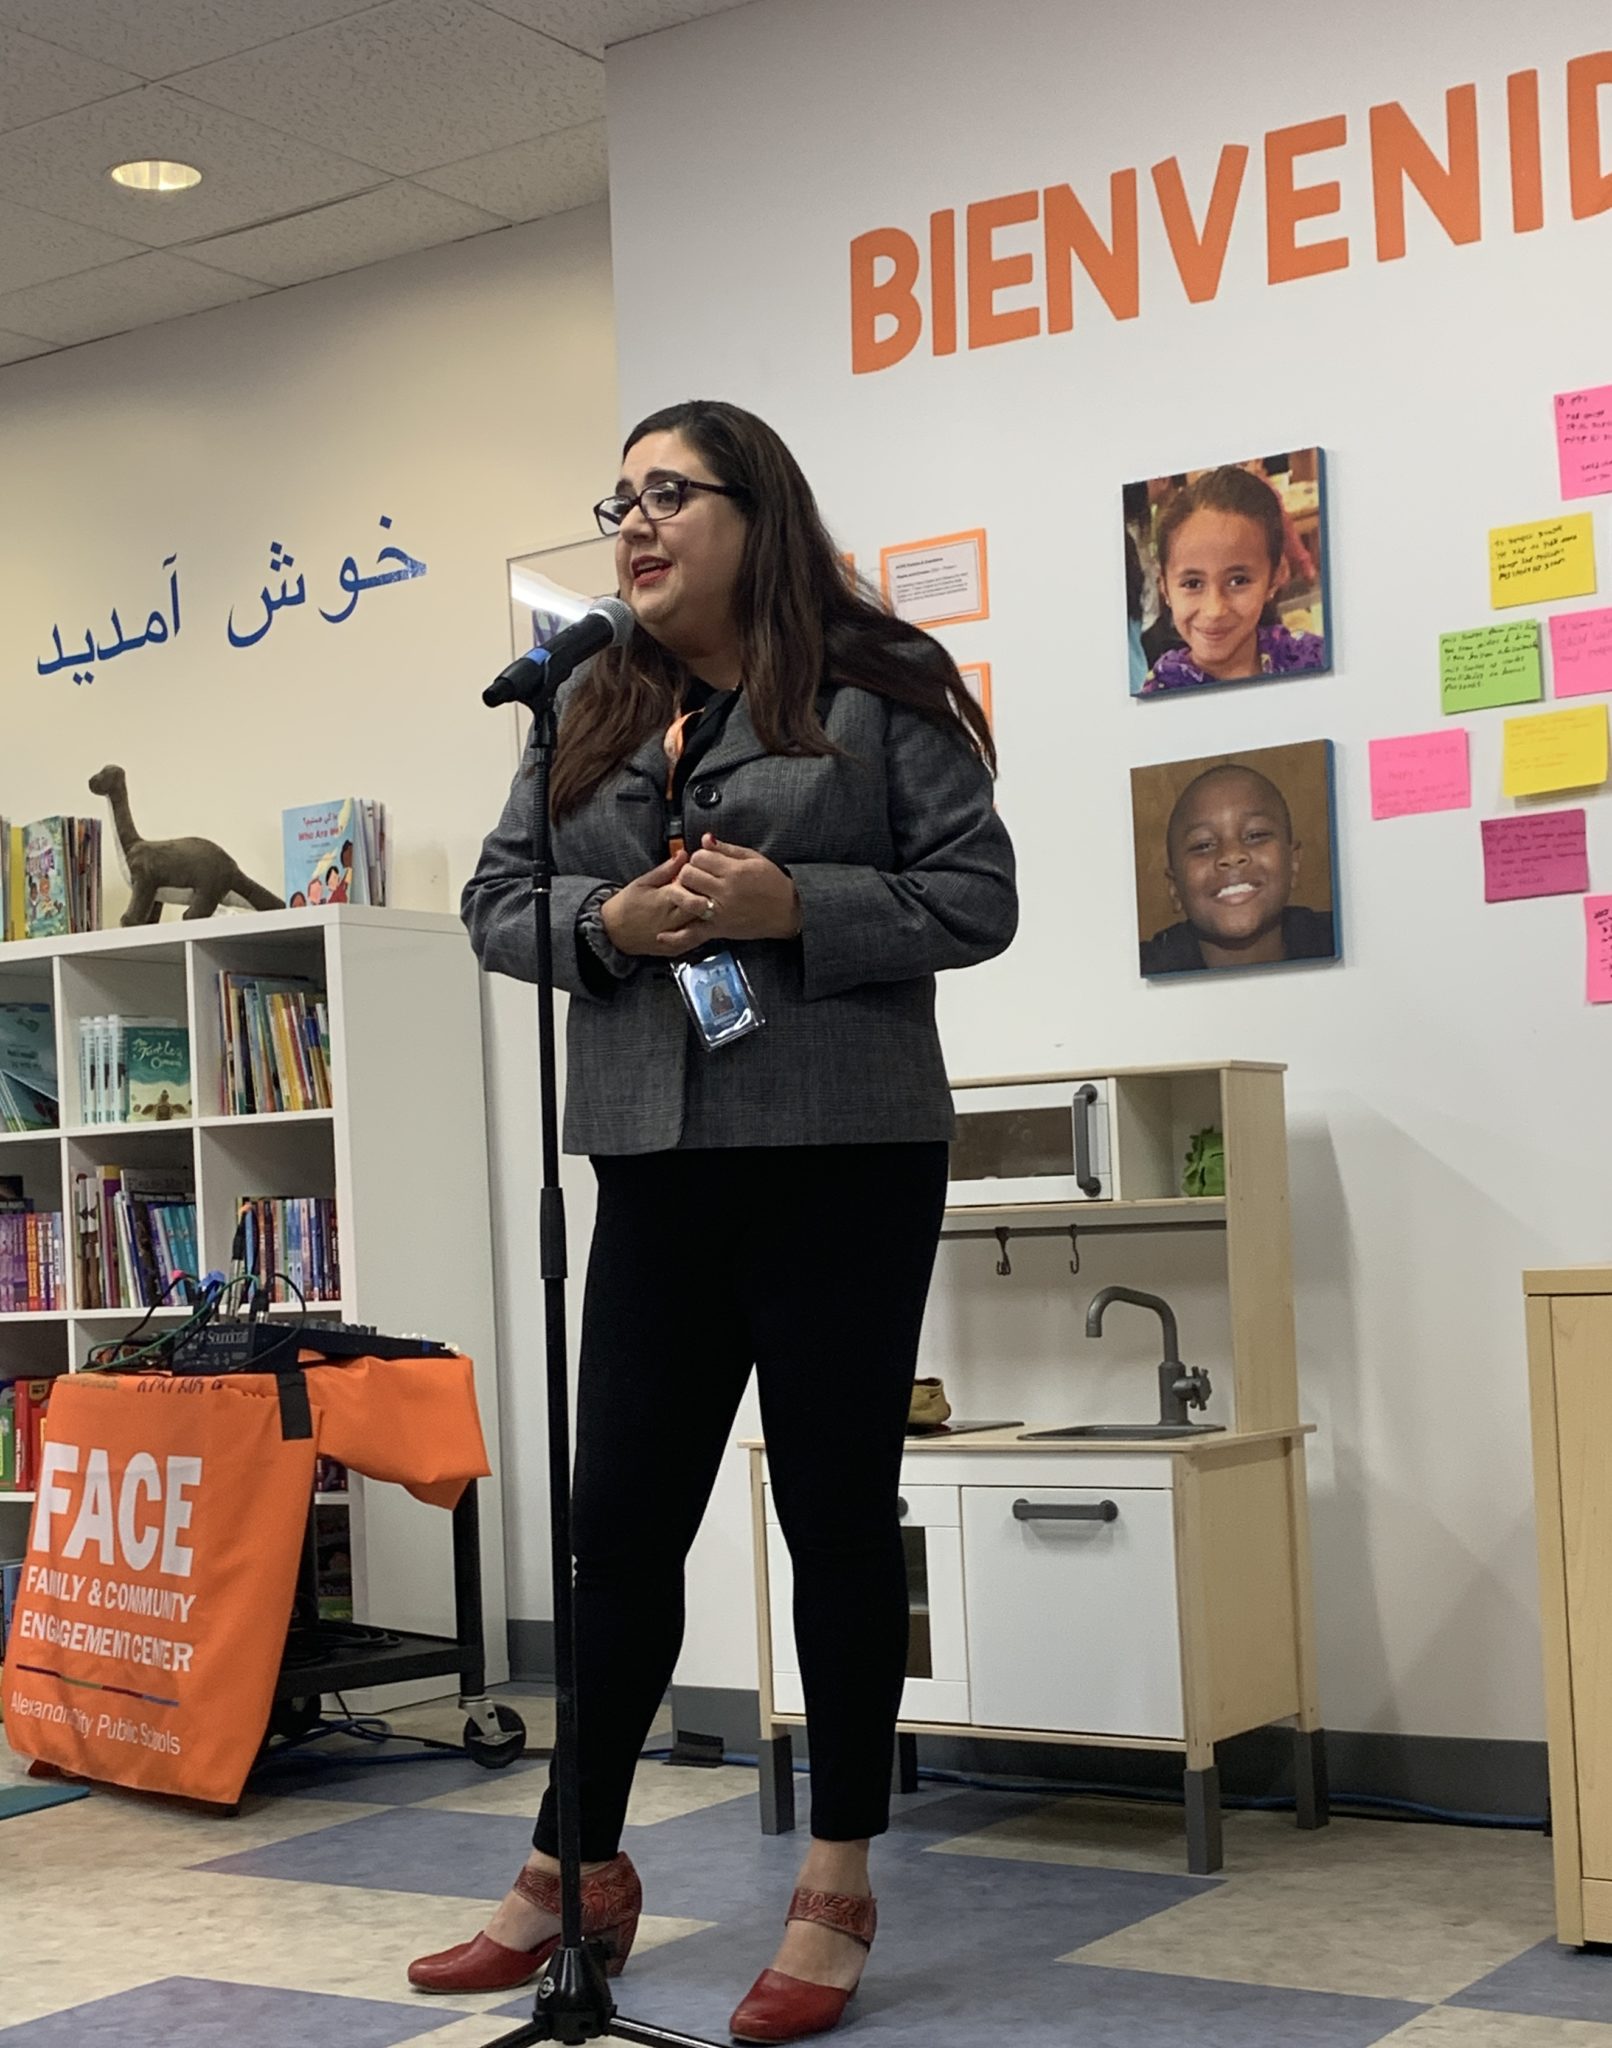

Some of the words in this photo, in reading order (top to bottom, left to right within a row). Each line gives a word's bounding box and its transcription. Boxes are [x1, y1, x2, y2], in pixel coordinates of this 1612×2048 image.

[36, 552, 182, 686] آمدید
[226, 514, 428, 649] خوش
[32, 1441, 202, 1577] FACE
[26, 1565, 87, 1602] FAMILY
[87, 1578, 102, 1607] &
[104, 1581, 197, 1623] COMMUNITY
[97, 1714, 139, 1743] Public
